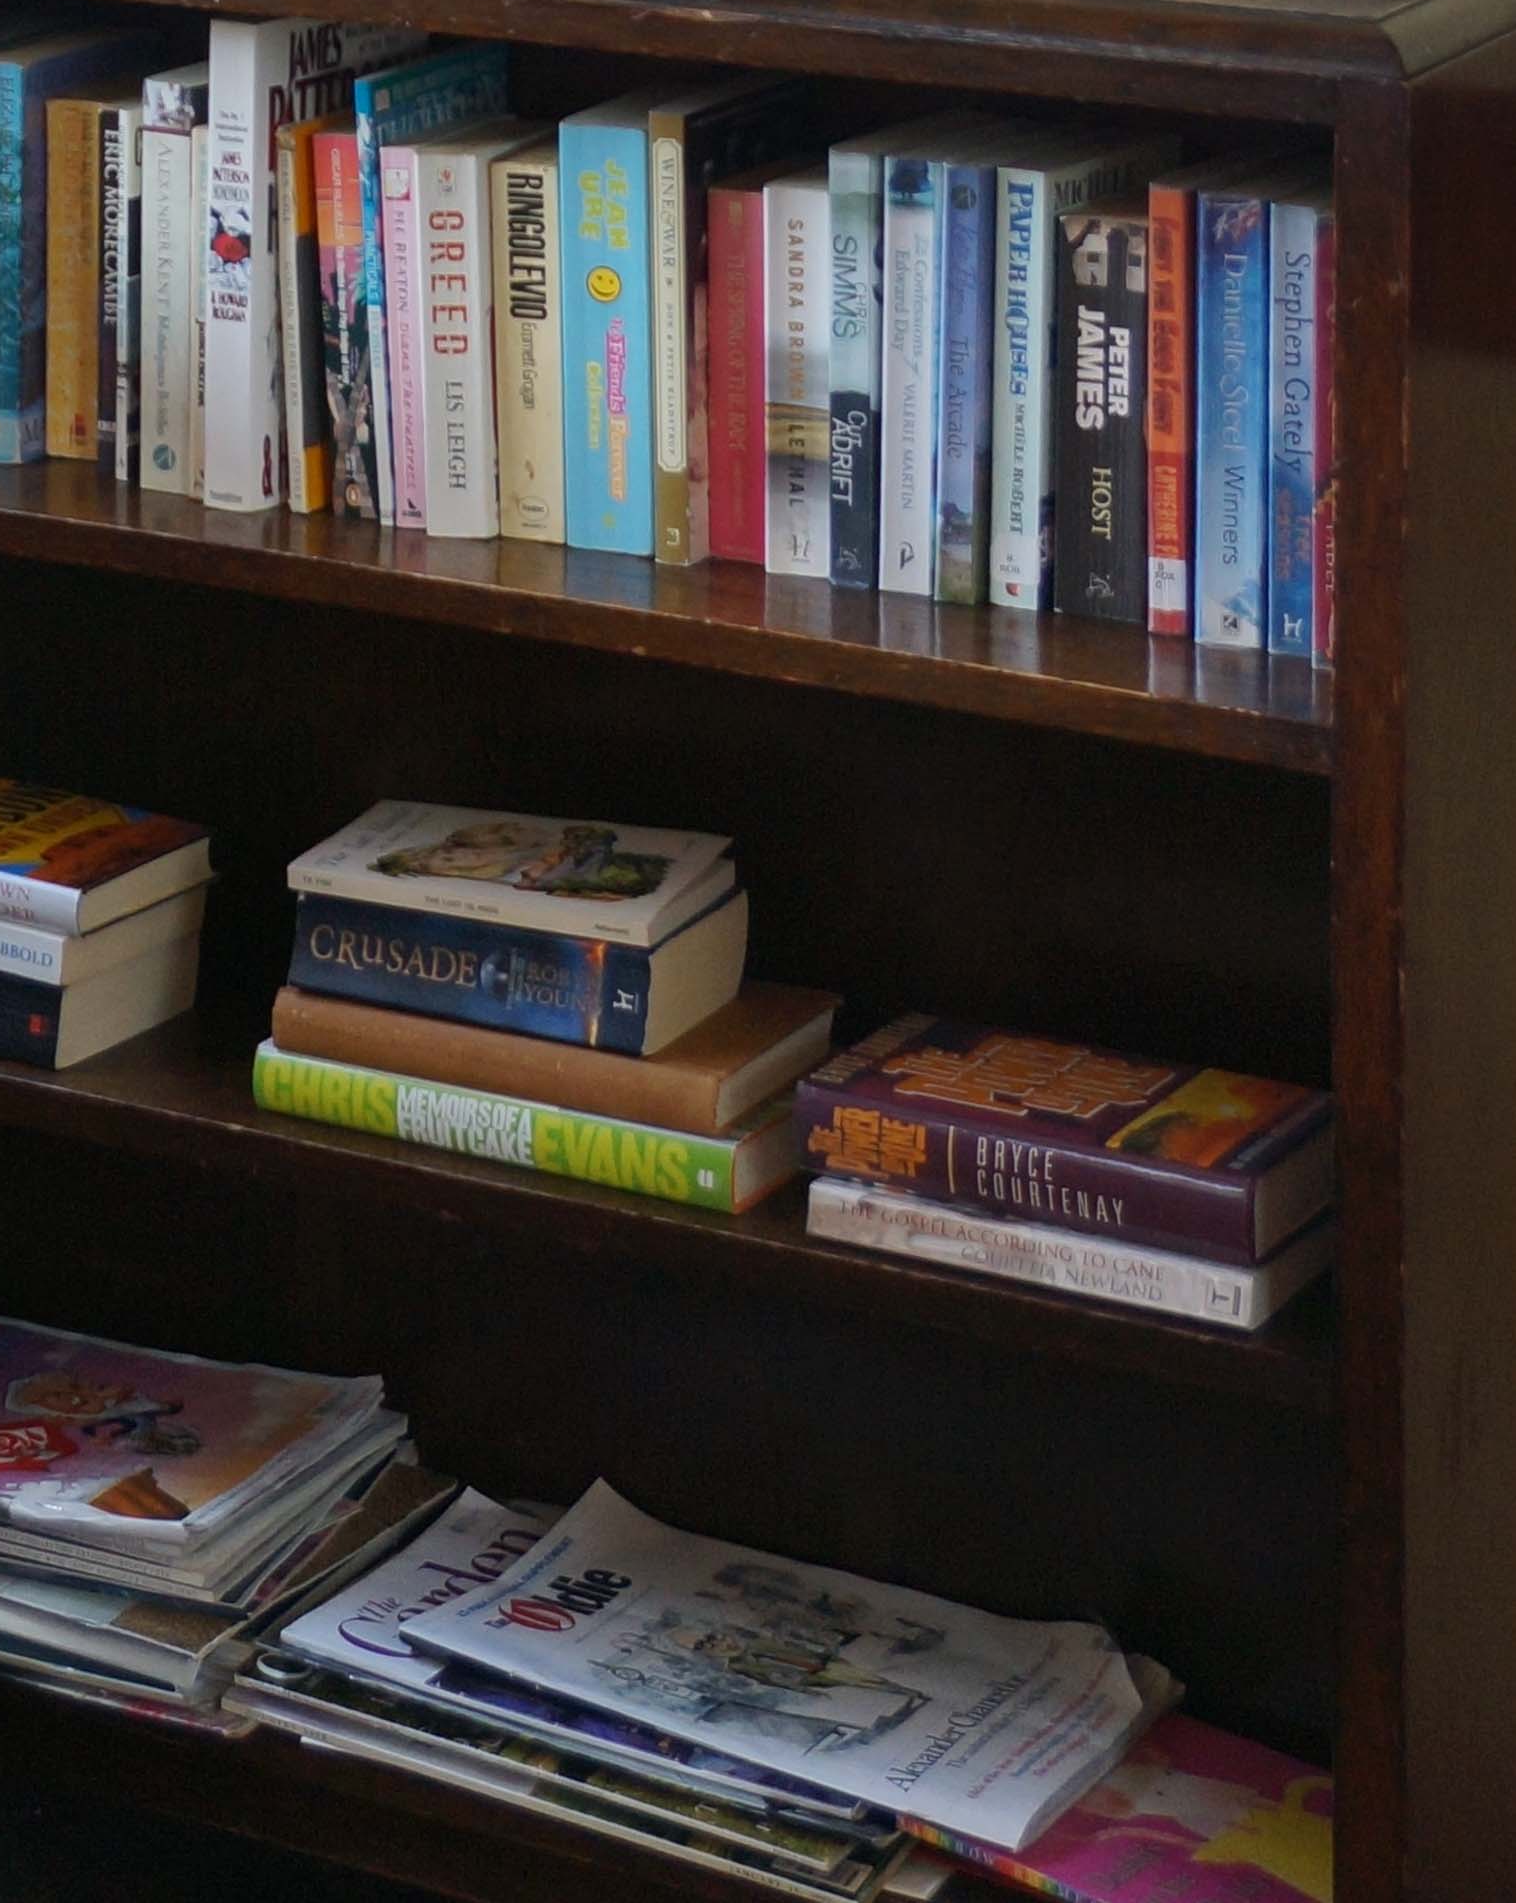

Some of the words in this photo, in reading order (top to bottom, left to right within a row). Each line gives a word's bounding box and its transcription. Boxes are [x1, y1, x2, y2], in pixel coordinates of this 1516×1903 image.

[102, 128, 119, 181] ERIC
[661, 157, 676, 209] WINE
[155, 142, 175, 251] ALEXANDER
[577, 169, 604, 240] URE
[605, 158, 630, 249] JEAN
[1006, 179, 1035, 281] PAPER
[102, 185, 119, 326] MORECAMBE
[154, 256, 175, 306] KENT
[429, 209, 469, 356] GREED
[507, 172, 549, 321] RINGOLEVIO
[662, 224, 677, 268] WAR
[788, 218, 804, 308] SANDRA
[894, 249, 910, 314] Edward
[832, 234, 858, 339] SIMMS
[911, 259, 929, 358] Confessions
[1224, 253, 1248, 371] Danielle
[1275, 251, 1314, 367] Stephen
[788, 321, 806, 400] BROWN
[890, 318, 909, 353] Day
[948, 336, 969, 377] The
[1004, 287, 1031, 397] HOUSES
[1075, 304, 1104, 431] JAMES
[1107, 326, 1129, 417] PETER
[445, 379, 465, 413] LIS
[610, 339, 626, 412] Friends
[1219, 372, 1250, 451] Steel
[447, 420, 467, 491] LEIGH
[947, 383, 968, 459] Arcade
[1274, 377, 1311, 475] Gately
[788, 423, 805, 508] LETHAL
[831, 417, 853, 508] ADRIFT
[901, 447, 916, 511] MARTIN
[1090, 466, 1112, 541] HOST
[1222, 464, 1247, 565] Winners
[309, 924, 479, 987] CRUSADE
[261, 1057, 396, 1138] CHRIS
[398, 1084, 493, 1130] MEMOIRS
[398, 1111, 535, 1167] FRUITCAKE
[534, 1114, 689, 1198] EVANS
[976, 1136, 1055, 1182] BRYCE
[976, 1168, 1124, 1227] COURTENAY
[880, 1209, 949, 1237] GOSPEL
[956, 1224, 1074, 1264] ACCORDING
[1080, 1251, 1107, 1270] TO
[1112, 1260, 1165, 1282] CANE
[1068, 1264, 1164, 1302] NEWLAND
[357, 1596, 402, 1624] The
[498, 1567, 632, 1632] Oldie
[885, 1726, 967, 1793] Alexander
